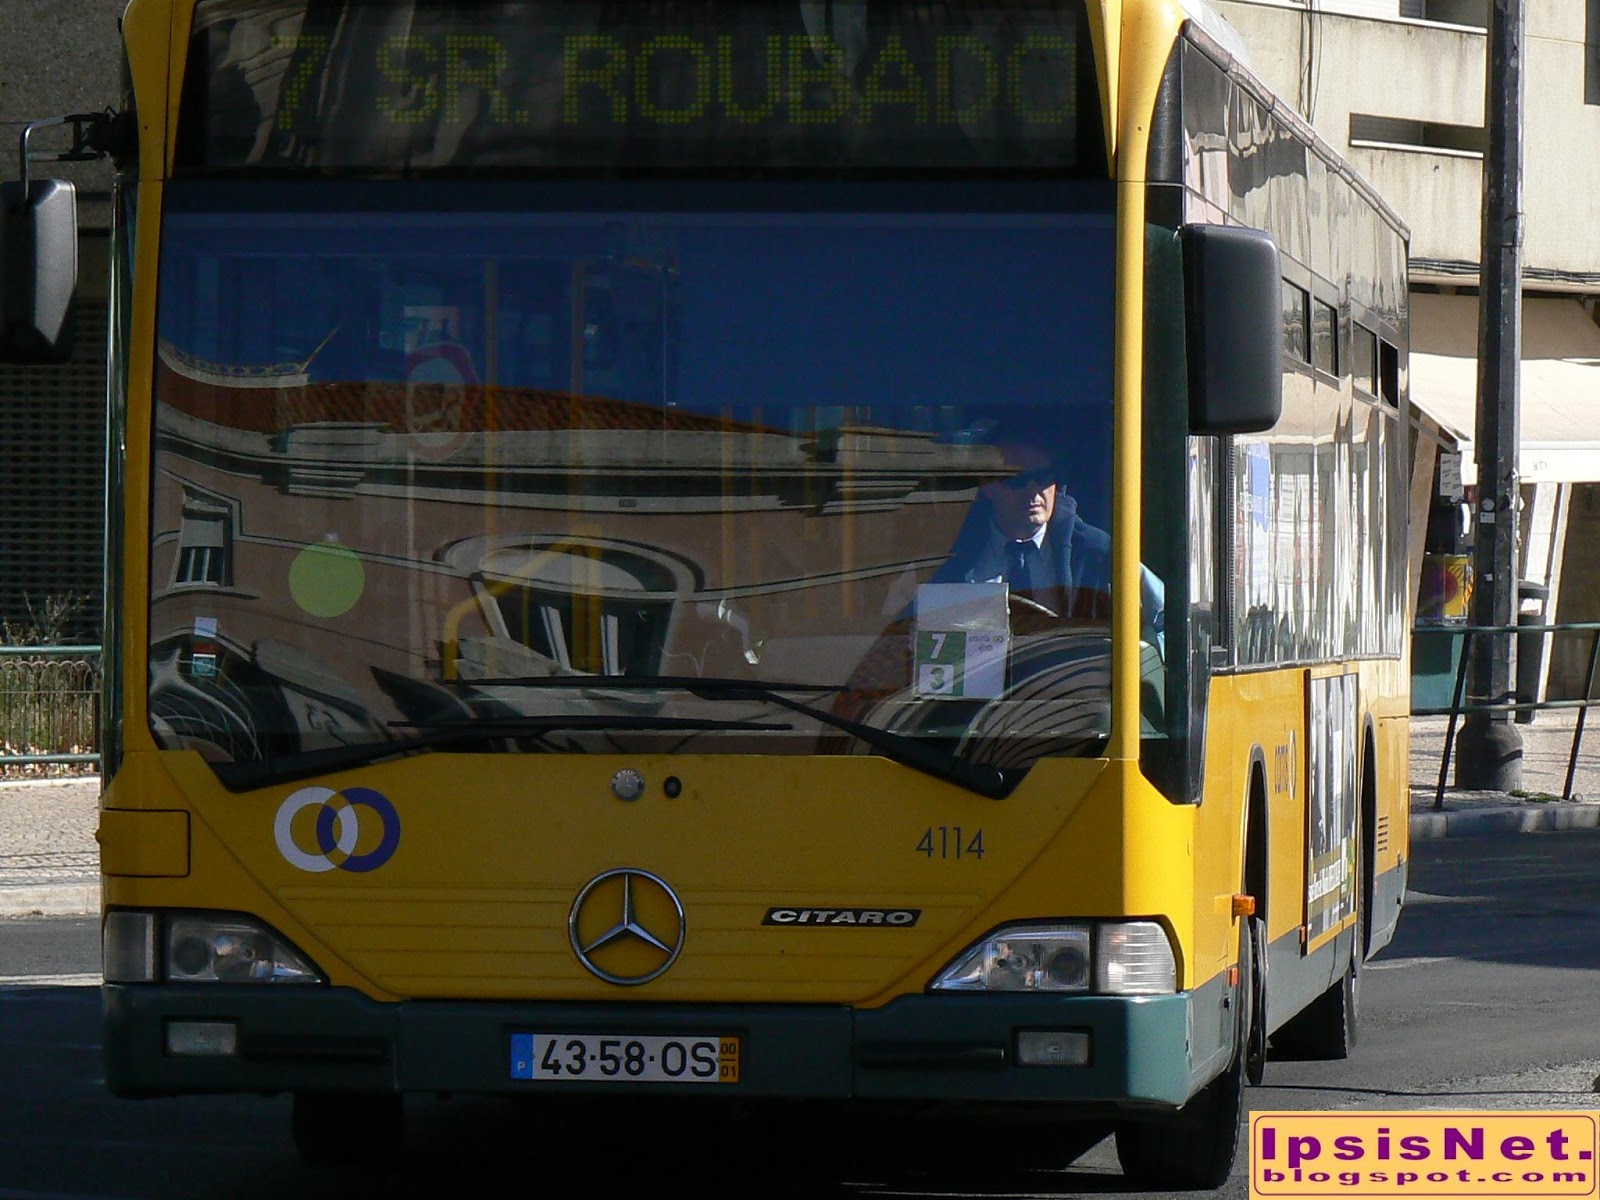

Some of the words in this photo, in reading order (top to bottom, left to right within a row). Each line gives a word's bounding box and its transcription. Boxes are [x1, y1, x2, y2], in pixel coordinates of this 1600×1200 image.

[274, 34, 326, 130] 7
[375, 34, 529, 125] SR.
[562, 33, 1077, 126] ROUBADO
[930, 633, 947, 660] 7
[929, 667, 946, 690] 3
[915, 826, 985, 860] 4114
[770, 909, 914, 925] CITARO
[517, 1060, 526, 1072] P
[721, 1064, 737, 1078] 01
